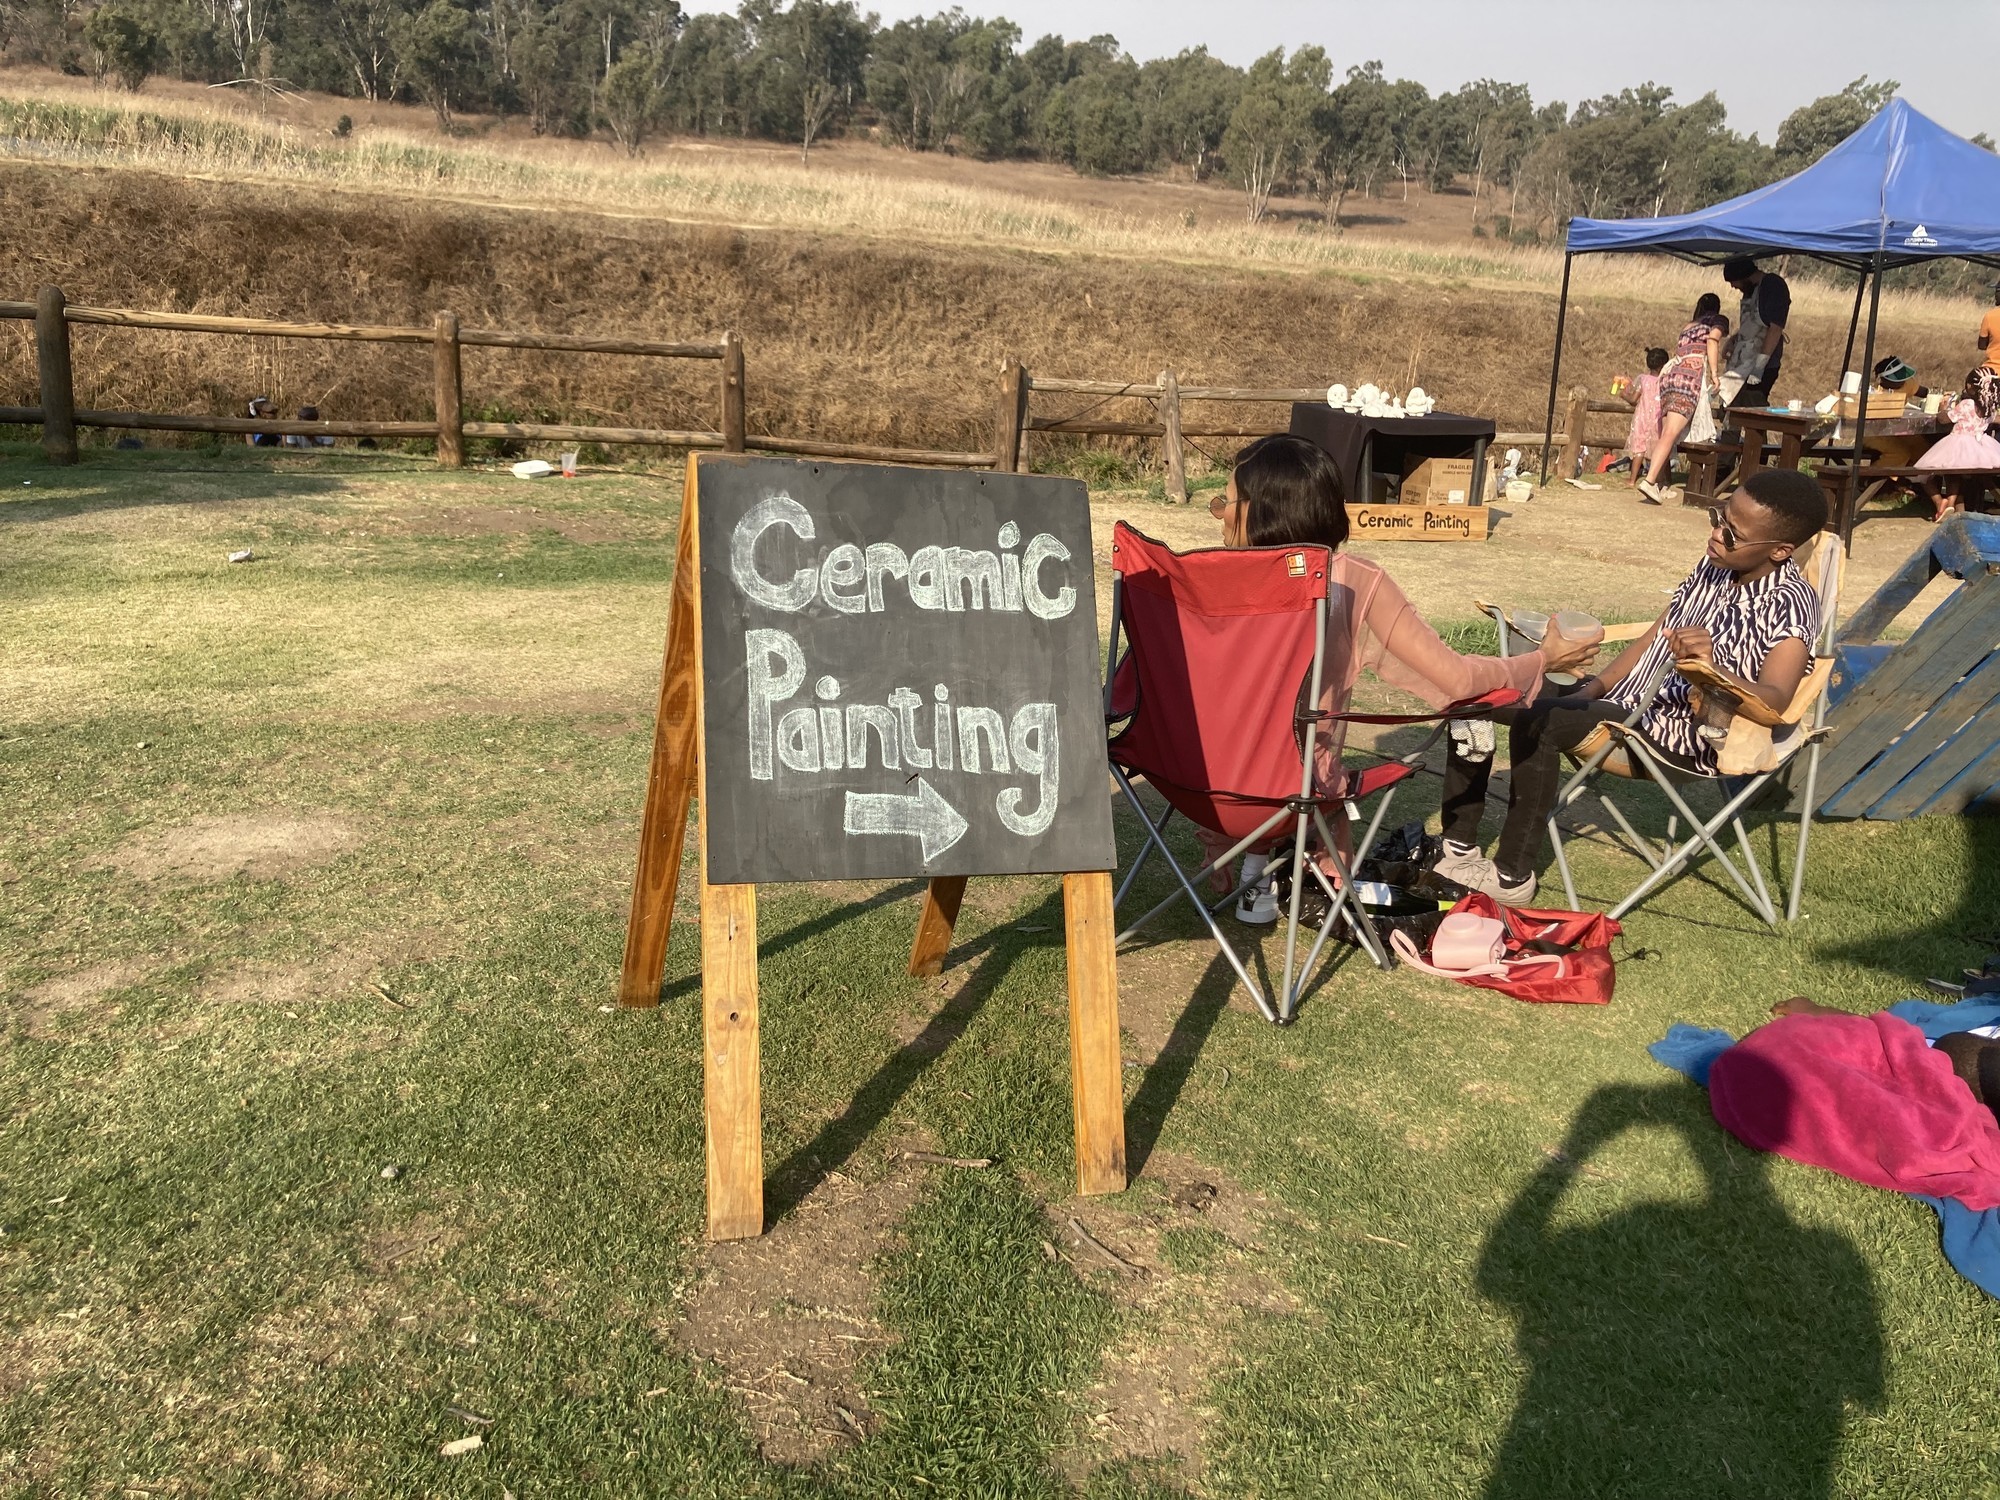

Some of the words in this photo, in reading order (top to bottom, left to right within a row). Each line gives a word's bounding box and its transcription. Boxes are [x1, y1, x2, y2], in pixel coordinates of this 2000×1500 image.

[731, 496, 1077, 620] Ceramic
[1357, 510, 1414, 528] Ceramic
[1423, 511, 1470, 538] Painting
[745, 628, 1060, 837] Painting
